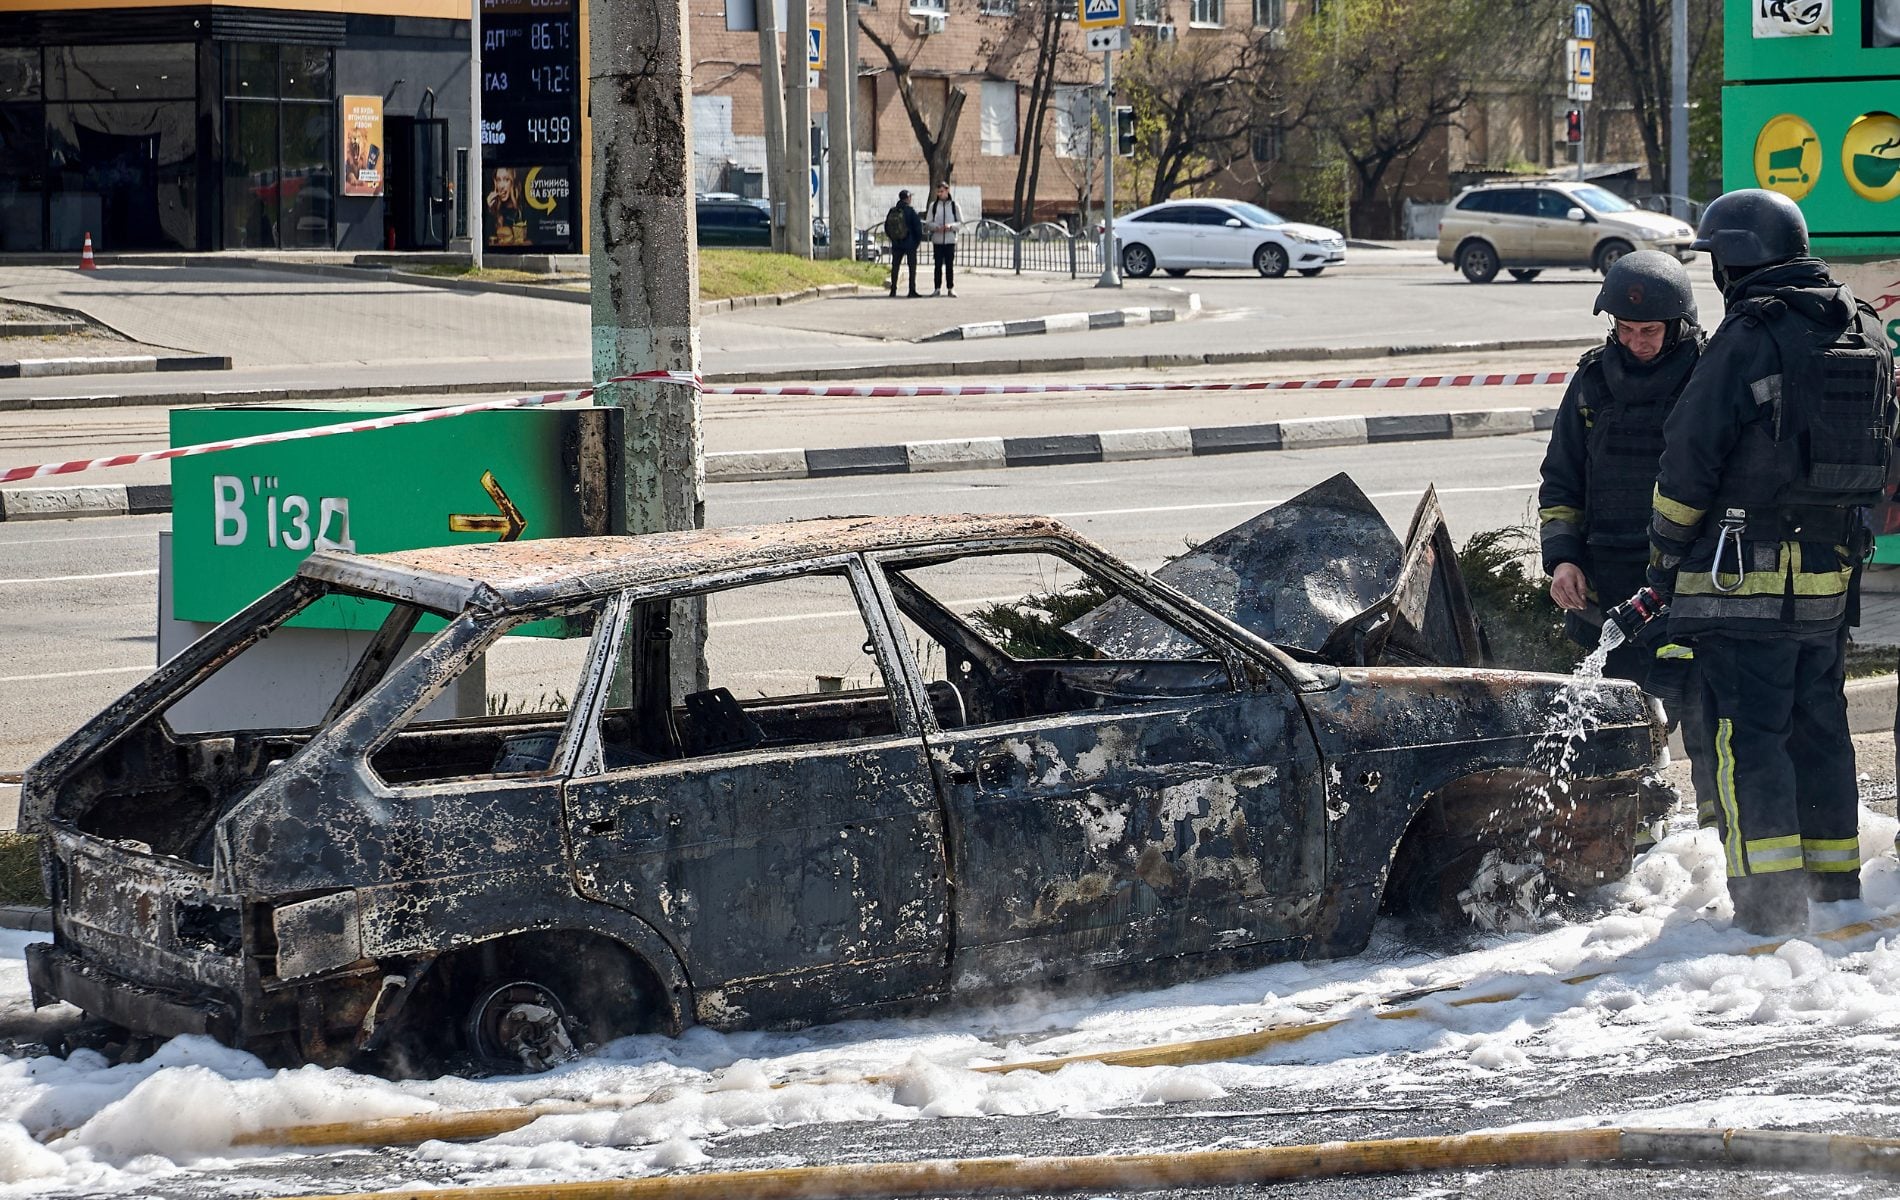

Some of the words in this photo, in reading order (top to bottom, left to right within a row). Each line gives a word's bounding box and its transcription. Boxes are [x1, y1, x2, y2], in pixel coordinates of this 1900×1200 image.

[485, 29, 505, 51] ДП
[485, 72, 508, 92] ГАЗ
[528, 115, 570, 144] 44.99
[542, 187, 570, 198] БУРГЕР
